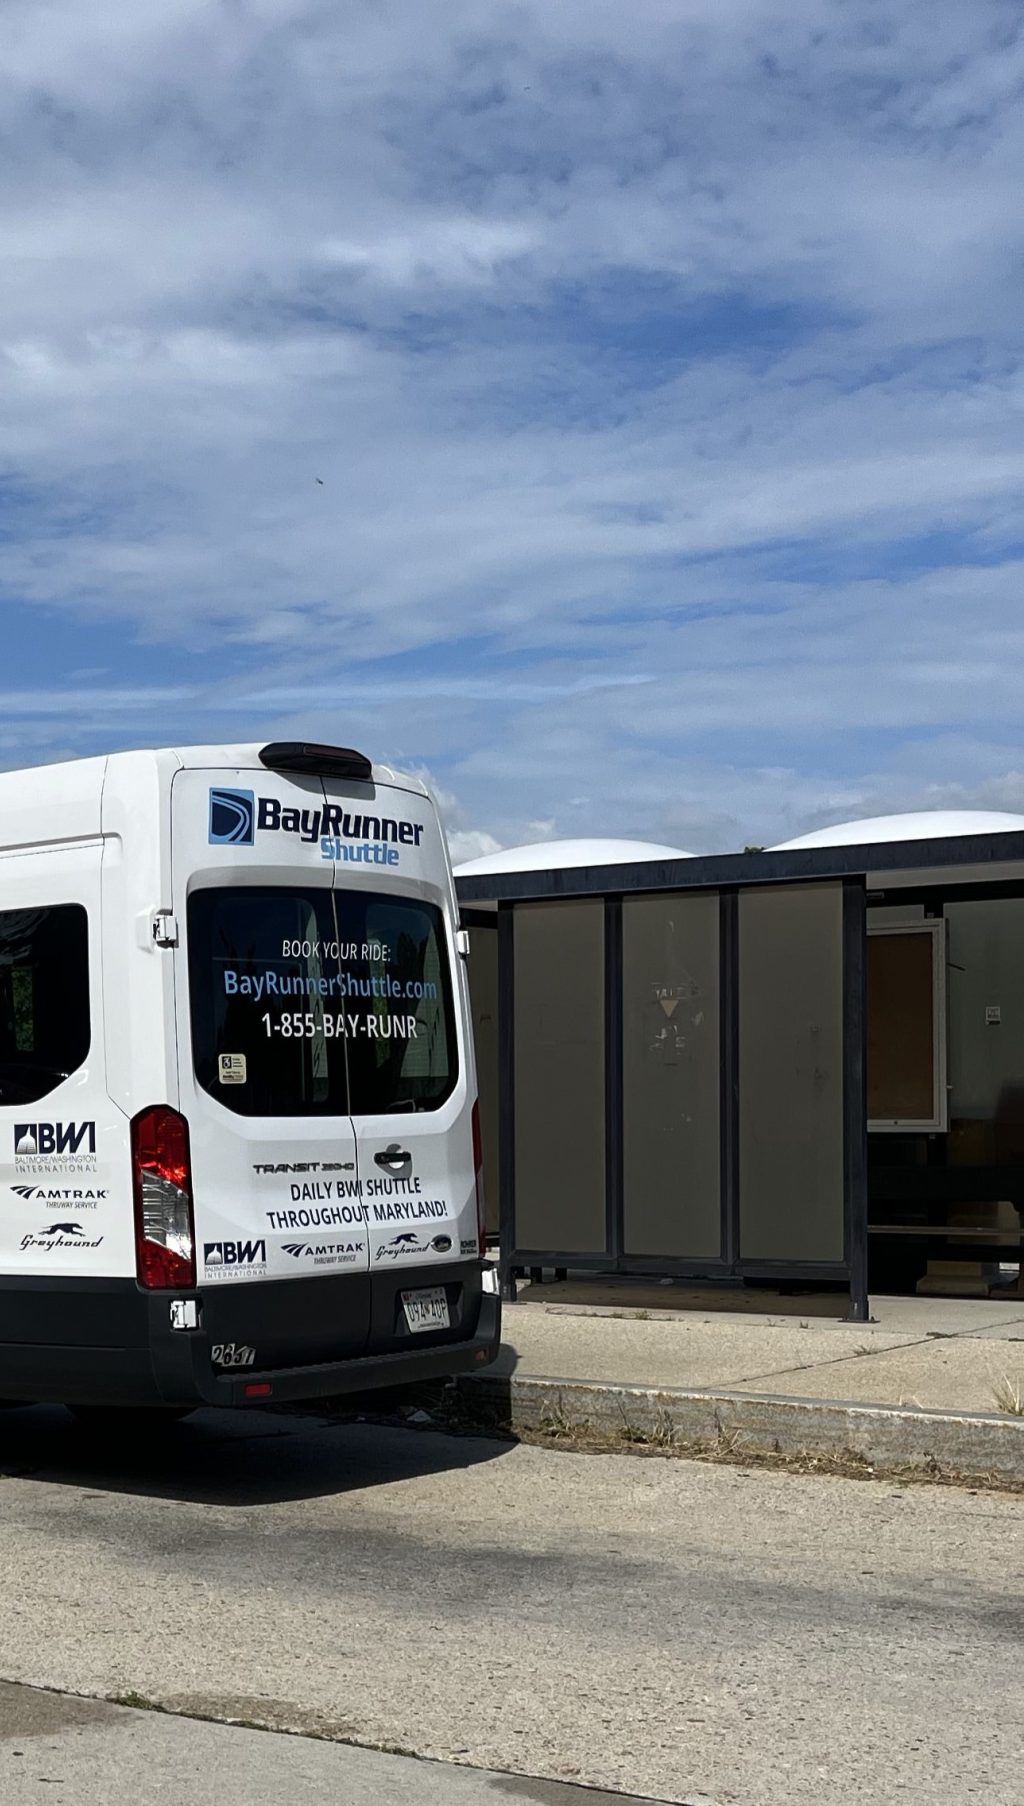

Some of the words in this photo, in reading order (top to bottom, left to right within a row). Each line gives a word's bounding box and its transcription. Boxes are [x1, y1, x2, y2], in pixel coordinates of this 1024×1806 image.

[257, 797, 424, 847] BayRunner
[321, 837, 399, 866] Shuttle
[282, 940, 320, 959] BOOK
[323, 942, 358, 960] YOUR
[361, 943, 391, 962] RIDE:
[224, 970, 437, 1001] BayRunnerShuttle.com
[261, 1012, 418, 1039] 1-855-BAY-RUNR
[38, 1121, 96, 1154] BWI
[14, 1154, 97, 1165] BALTIMORE/WASHINGTON
[16, 1164, 98, 1173] INTERNATIONAL
[253, 1162, 320, 1174] TRANSIT
[36, 1189, 107, 1199] AMTRAK
[290, 1181, 332, 1201] DAILY
[336, 1179, 364, 1198] BWI
[367, 1177, 422, 1196] SHUTTLE
[46, 1201, 74, 1209] THRUWAY
[74, 1201, 98, 1209] SERVICE
[266, 1204, 371, 1230] THROUGHOUT
[375, 1200, 448, 1222] MARYLAND!
[19, 1234, 105, 1251] Greyhound
[223, 1240, 266, 1264] BWI
[305, 1242, 364, 1256] AMTRAK
[375, 1242, 431, 1261] Greyhound
[205, 1270, 266, 1279] INTERNATIONAL
